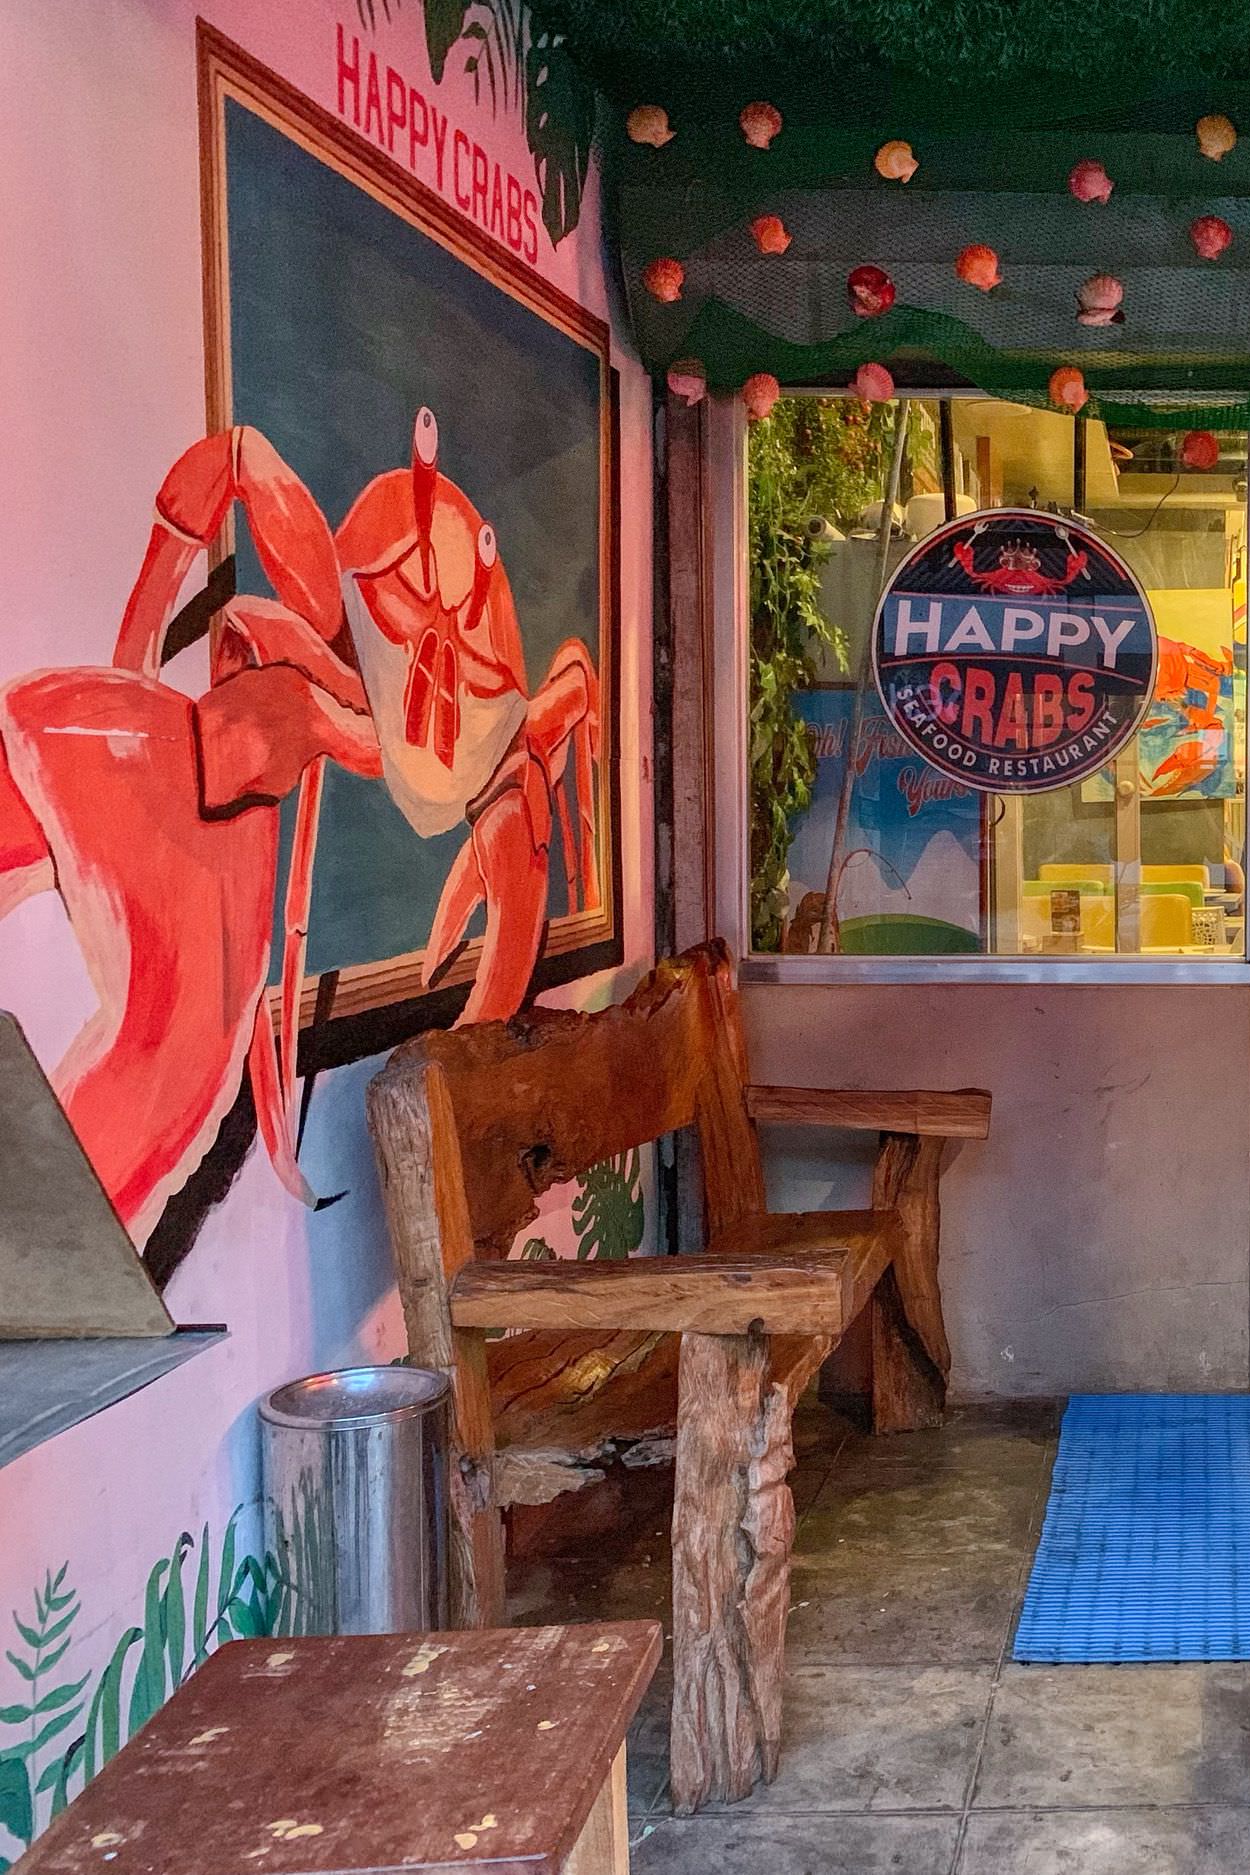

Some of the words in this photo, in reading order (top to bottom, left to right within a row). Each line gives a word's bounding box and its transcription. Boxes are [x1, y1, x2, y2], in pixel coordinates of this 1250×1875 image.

[337, 23, 447, 191] HAPPY
[454, 129, 538, 265] CRABS
[895, 600, 1136, 669] HAPPY
[896, 683, 977, 767] SEAFOOD
[988, 710, 1119, 777] RESTAURANT
[929, 661, 1096, 750] CRABS
